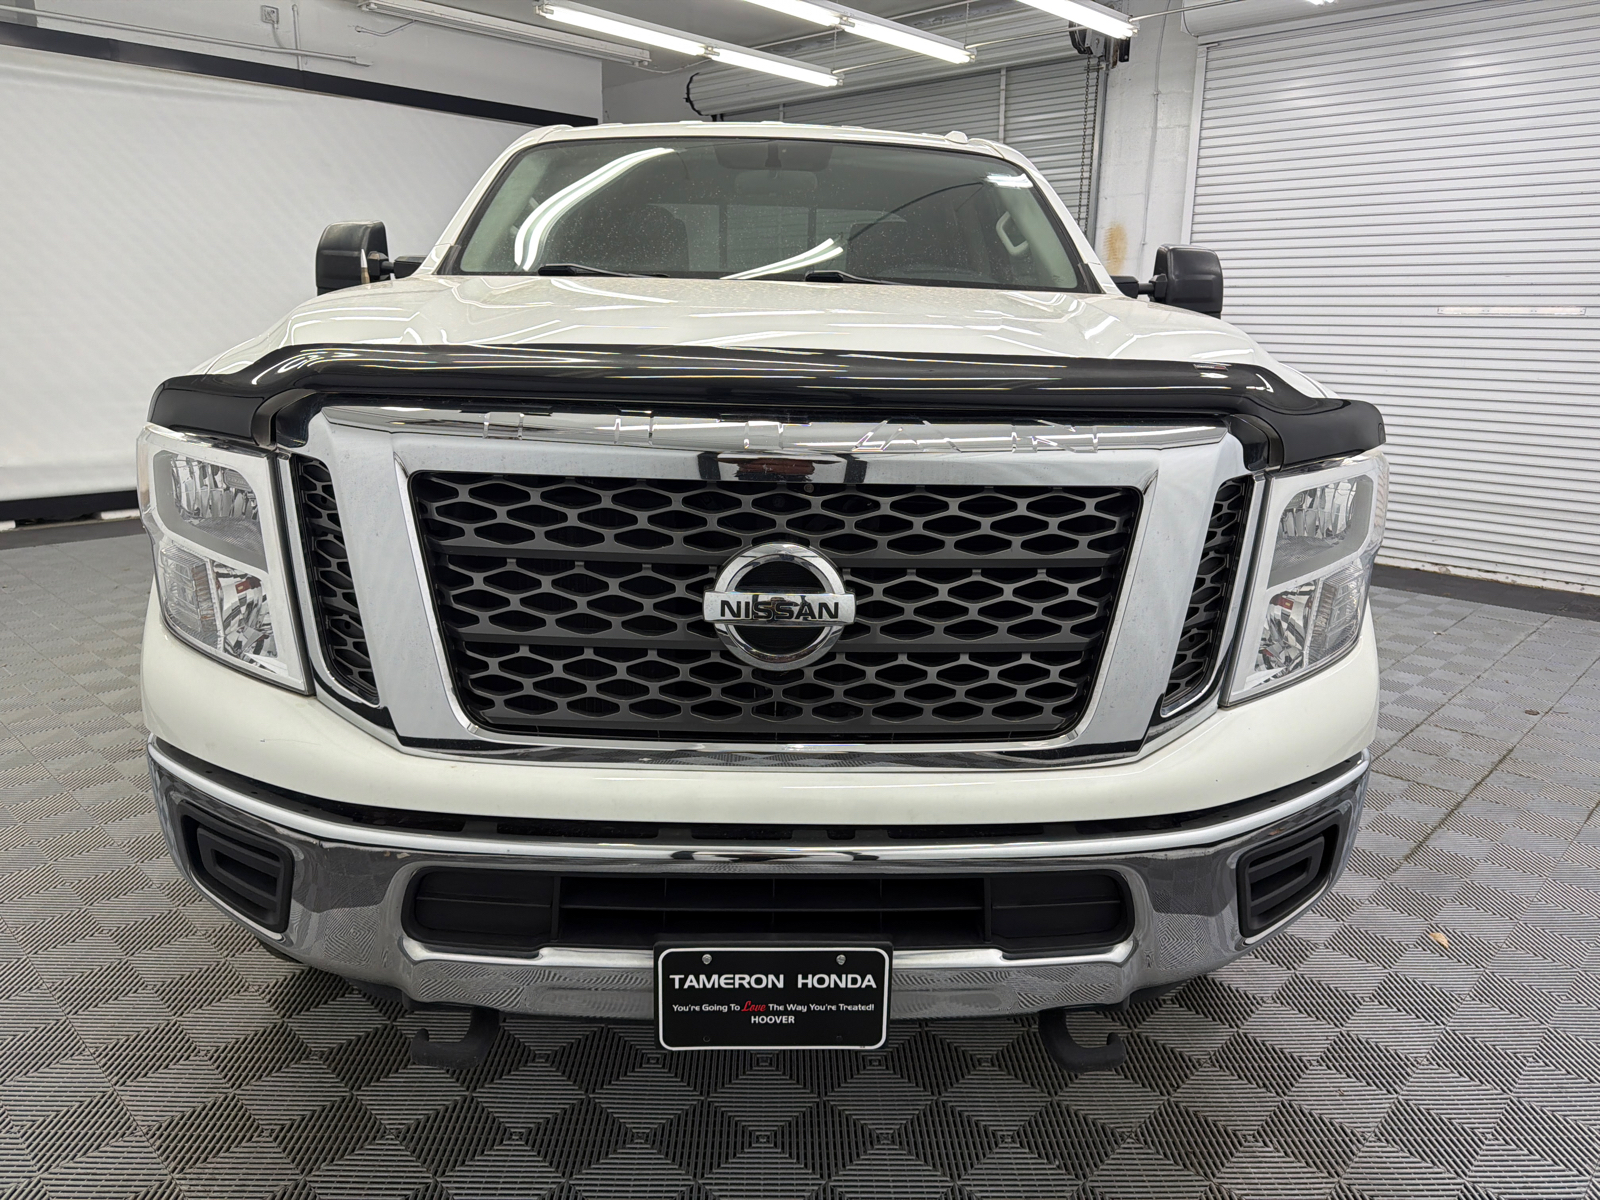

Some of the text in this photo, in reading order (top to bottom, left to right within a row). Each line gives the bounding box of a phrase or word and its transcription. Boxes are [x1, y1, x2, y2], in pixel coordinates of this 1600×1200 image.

[720, 600, 839, 620] NISSAN
[669, 973, 877, 989] TAMERON HONDA
[672, 1000, 875, 1013] You're Going To Love The Way You're Treated!
[751, 1015, 795, 1024] HOOVER
